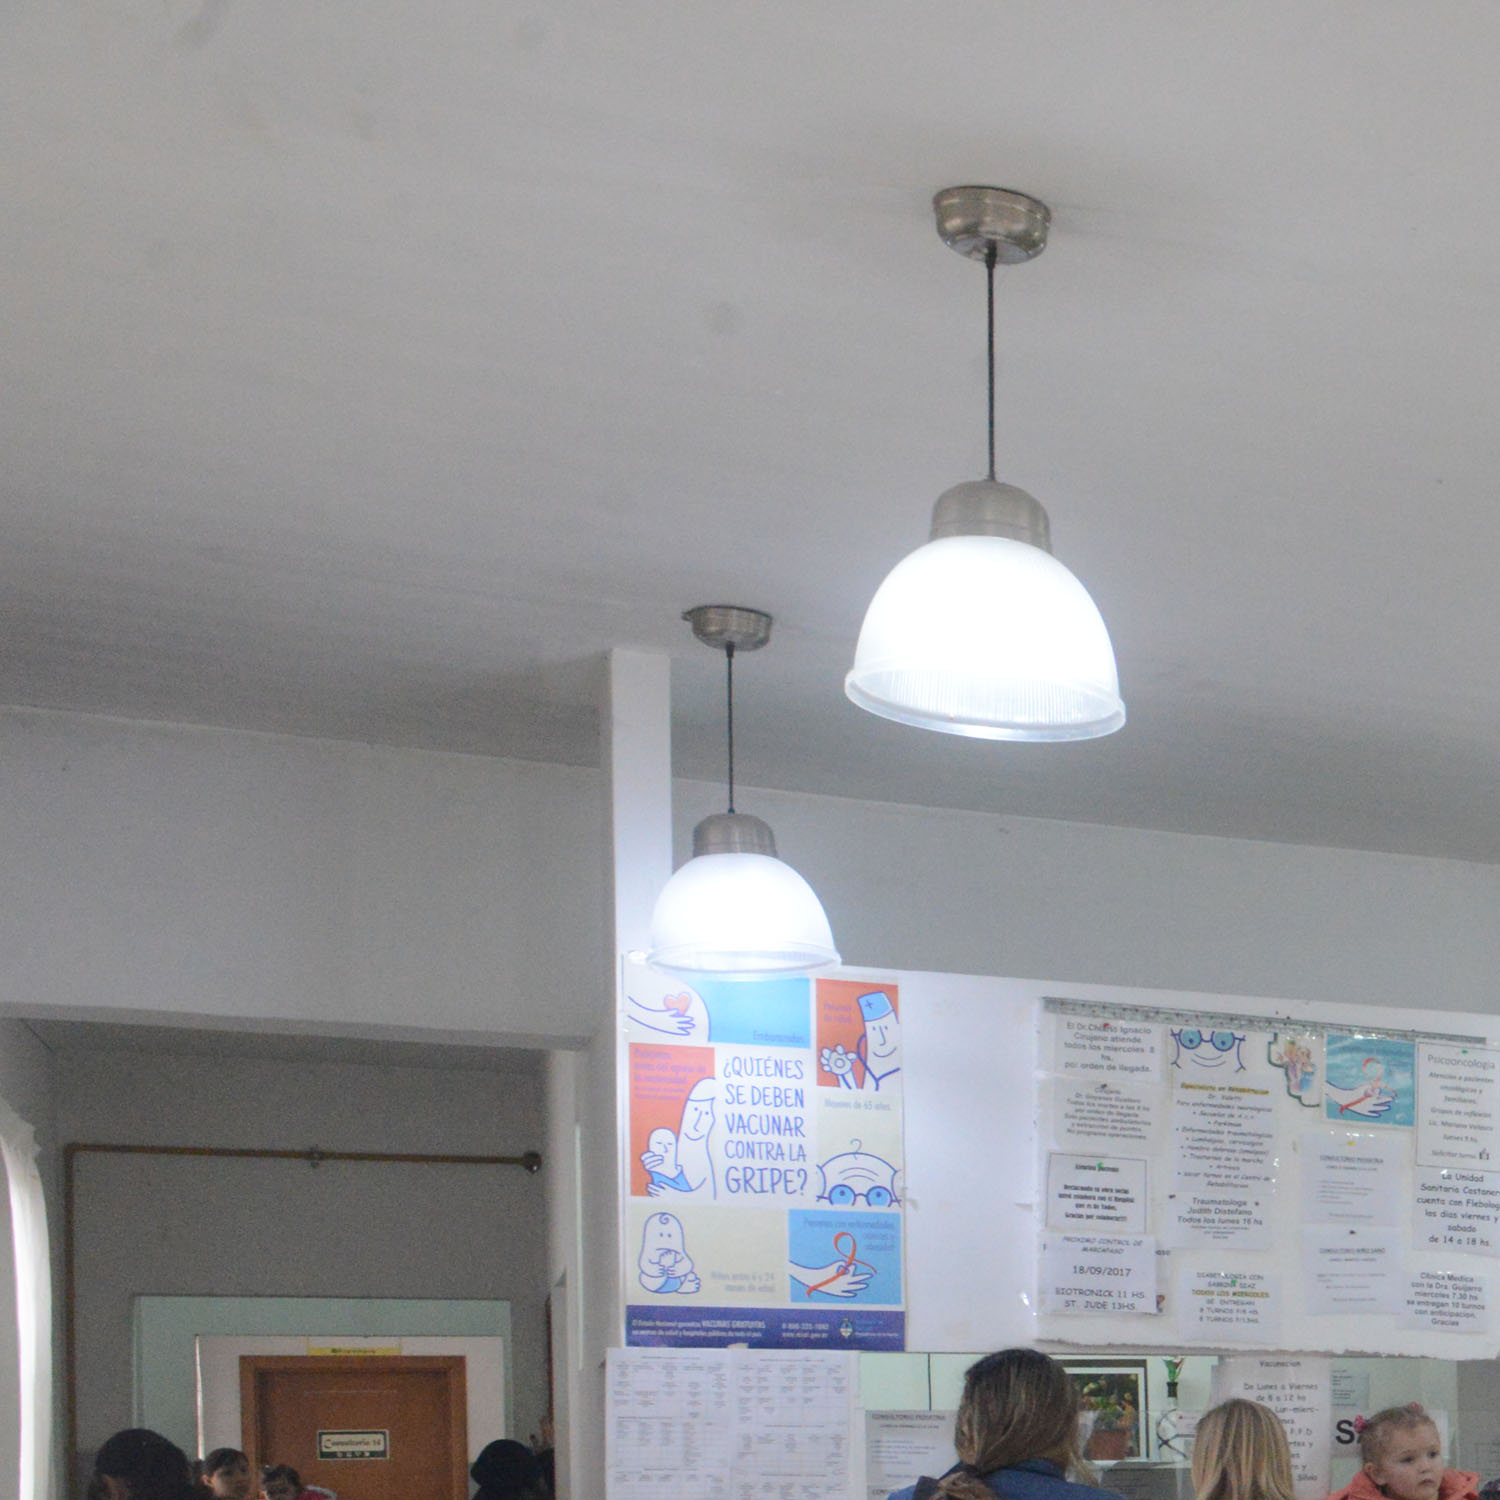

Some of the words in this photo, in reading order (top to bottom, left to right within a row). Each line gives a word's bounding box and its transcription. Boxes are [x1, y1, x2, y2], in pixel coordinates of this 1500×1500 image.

[1074, 1033, 1108, 1042] Cirujano
[723, 1056, 804, 1079] ¿QUIÉNES
[1119, 1065, 1152, 1073] llegada.
[725, 1084, 746, 1104] SE
[751, 1086, 804, 1108] DEBEN
[725, 1114, 805, 1137] VACUNAR
[725, 1141, 784, 1161] CONTRA
[789, 1143, 807, 1162] LA
[725, 1167, 807, 1195] GRIPE?
[1455, 1173, 1484, 1182] Unidad
[1421, 1184, 1459, 1193] Sanitaria
[1417, 1197, 1445, 1205] cuenta
[1425, 1209, 1436, 1217] los
[1461, 1212, 1490, 1221] viernes
[1178, 1216, 1201, 1224] Todos
[1218, 1217, 1239, 1225] lunes
[1429, 1235, 1439, 1243] de
[1073, 1265, 1131, 1277] 18/09/2017
[1056, 1287, 1113, 1298] BIOTRONICK
[1118, 1289, 1127, 1298] 11
[1084, 1301, 1108, 1309] JUDE
[1417, 1300, 1448, 1309] entregan
[1431, 1318, 1459, 1326] Gracias
